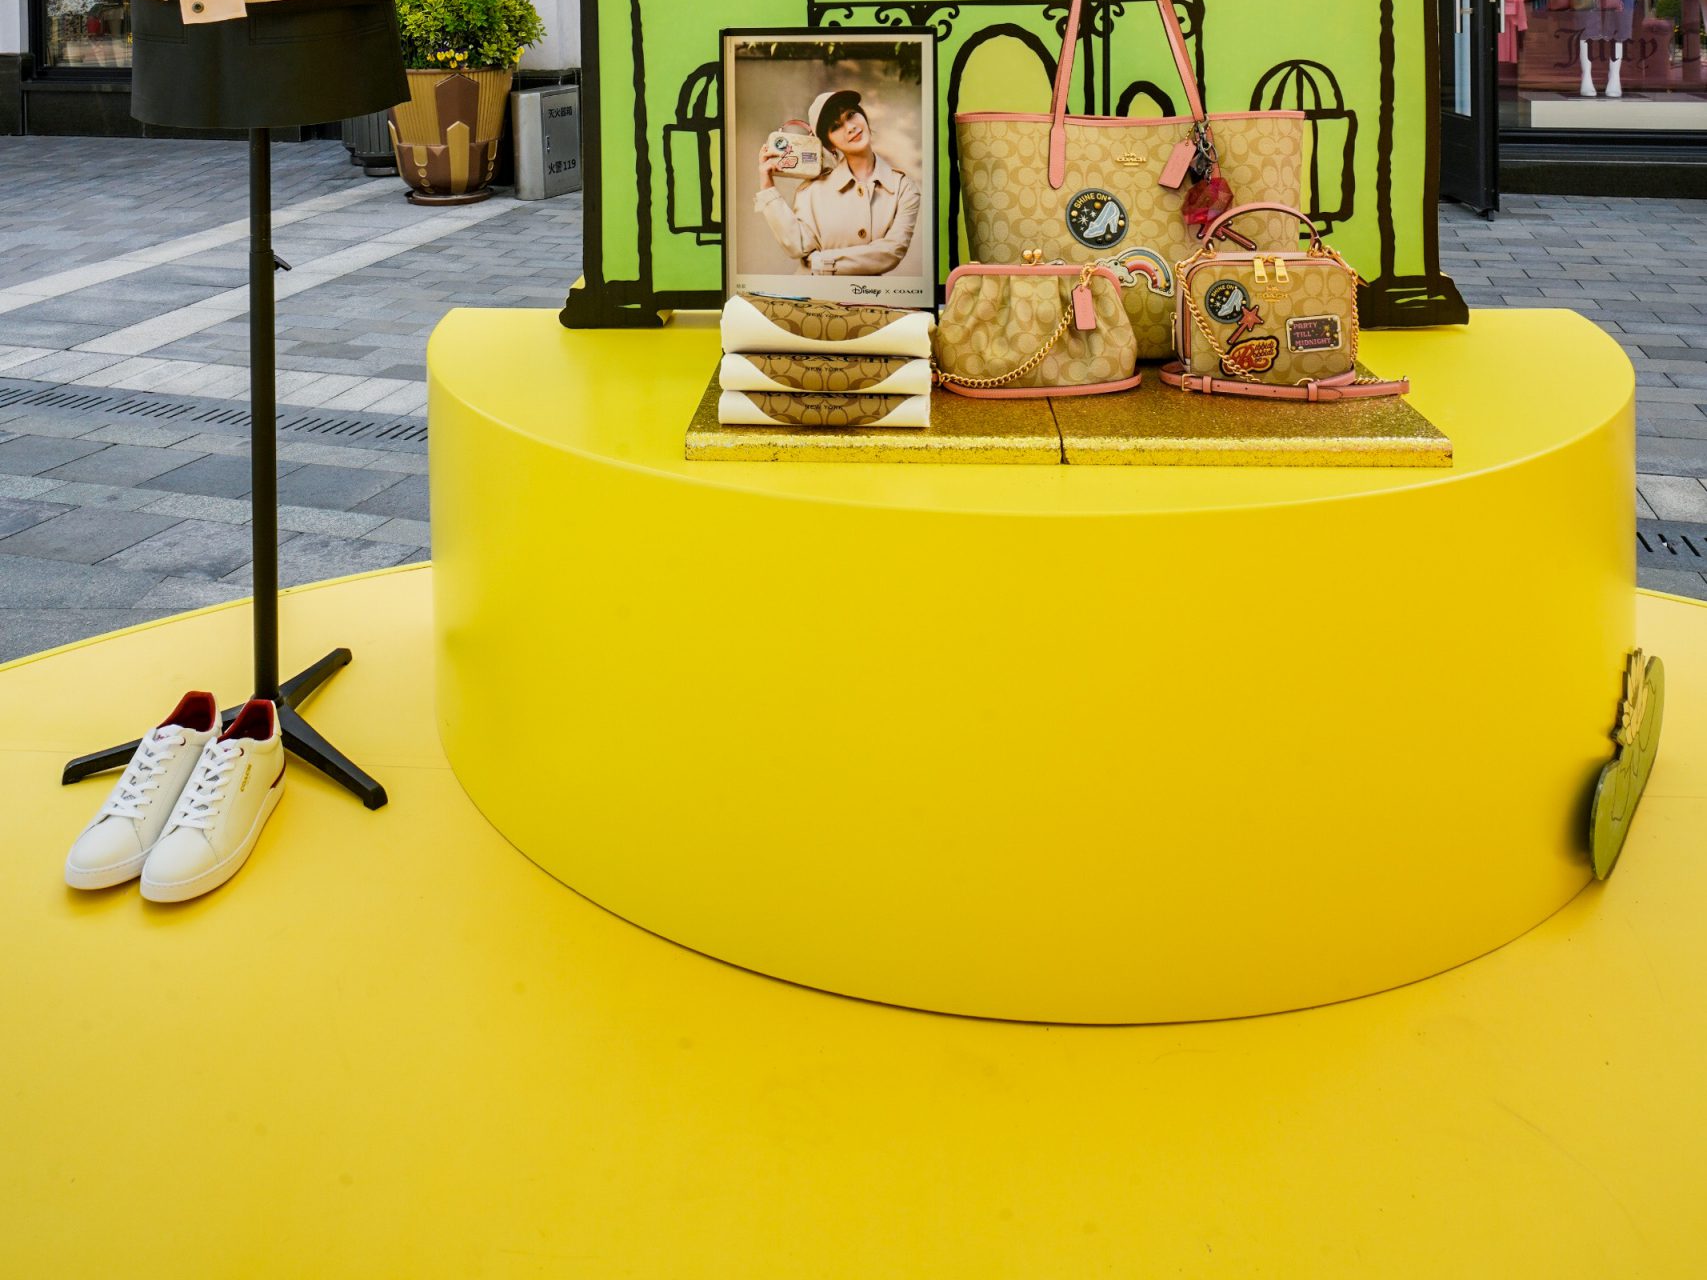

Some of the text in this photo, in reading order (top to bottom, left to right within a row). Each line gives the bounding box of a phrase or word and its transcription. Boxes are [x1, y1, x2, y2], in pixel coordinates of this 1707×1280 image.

[1553, 27, 1659, 70] Juicy
[1073, 192, 1108, 209] SHINE ON
[850, 283, 882, 297] Disney
[1211, 285, 1226, 297] SHINE
[1293, 321, 1318, 329] PARTY
[1295, 338, 1332, 347] MIDNIGHT
